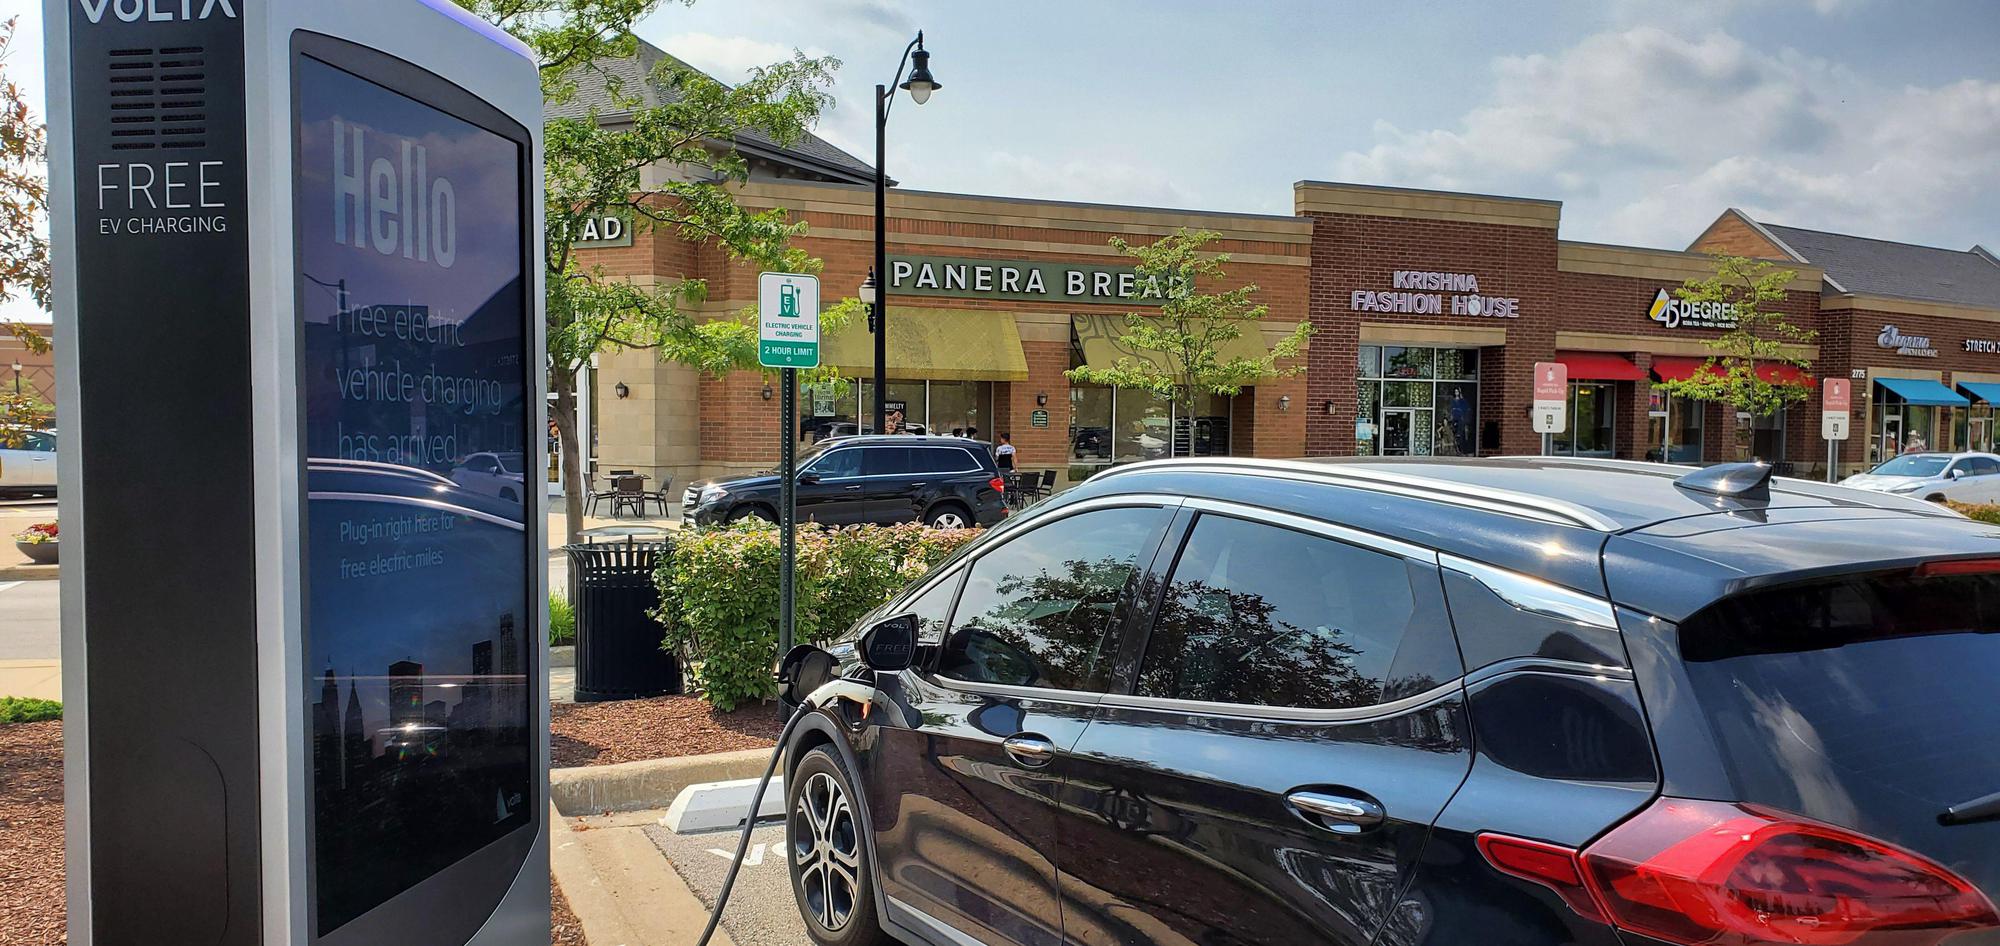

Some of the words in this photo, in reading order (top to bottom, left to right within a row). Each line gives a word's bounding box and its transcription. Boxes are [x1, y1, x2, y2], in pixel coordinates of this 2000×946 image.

[98, 161, 225, 209] FREE
[333, 120, 456, 268] Hello
[100, 218, 121, 234] EV
[127, 216, 226, 234] CHARGING
[892, 260, 1047, 295] PANERA
[1393, 270, 1479, 293] KRISHNA
[336, 289, 387, 338] Free
[394, 299, 465, 347] electric
[1351, 290, 1442, 315] FASHION
[1451, 294, 1519, 318] HOUSE
[791, 323, 813, 331] VEHICLE
[765, 346, 770, 354] 2
[772, 346, 792, 355] HOUR
[793, 347, 814, 356] LIMIT
[1965, 339, 1996, 353] STRETCH
[336, 356, 414, 402] vehicle
[421, 363, 501, 415] charging
[338, 422, 379, 463] has
[387, 424, 457, 465] arrived
[340, 518, 382, 545] Plug-in
[386, 515, 412, 541] right
[415, 513, 438, 533] here
[441, 511, 455, 530] for
[341, 557, 366, 579] free
[370, 550, 412, 575] electric
[416, 547, 443, 568] miles
